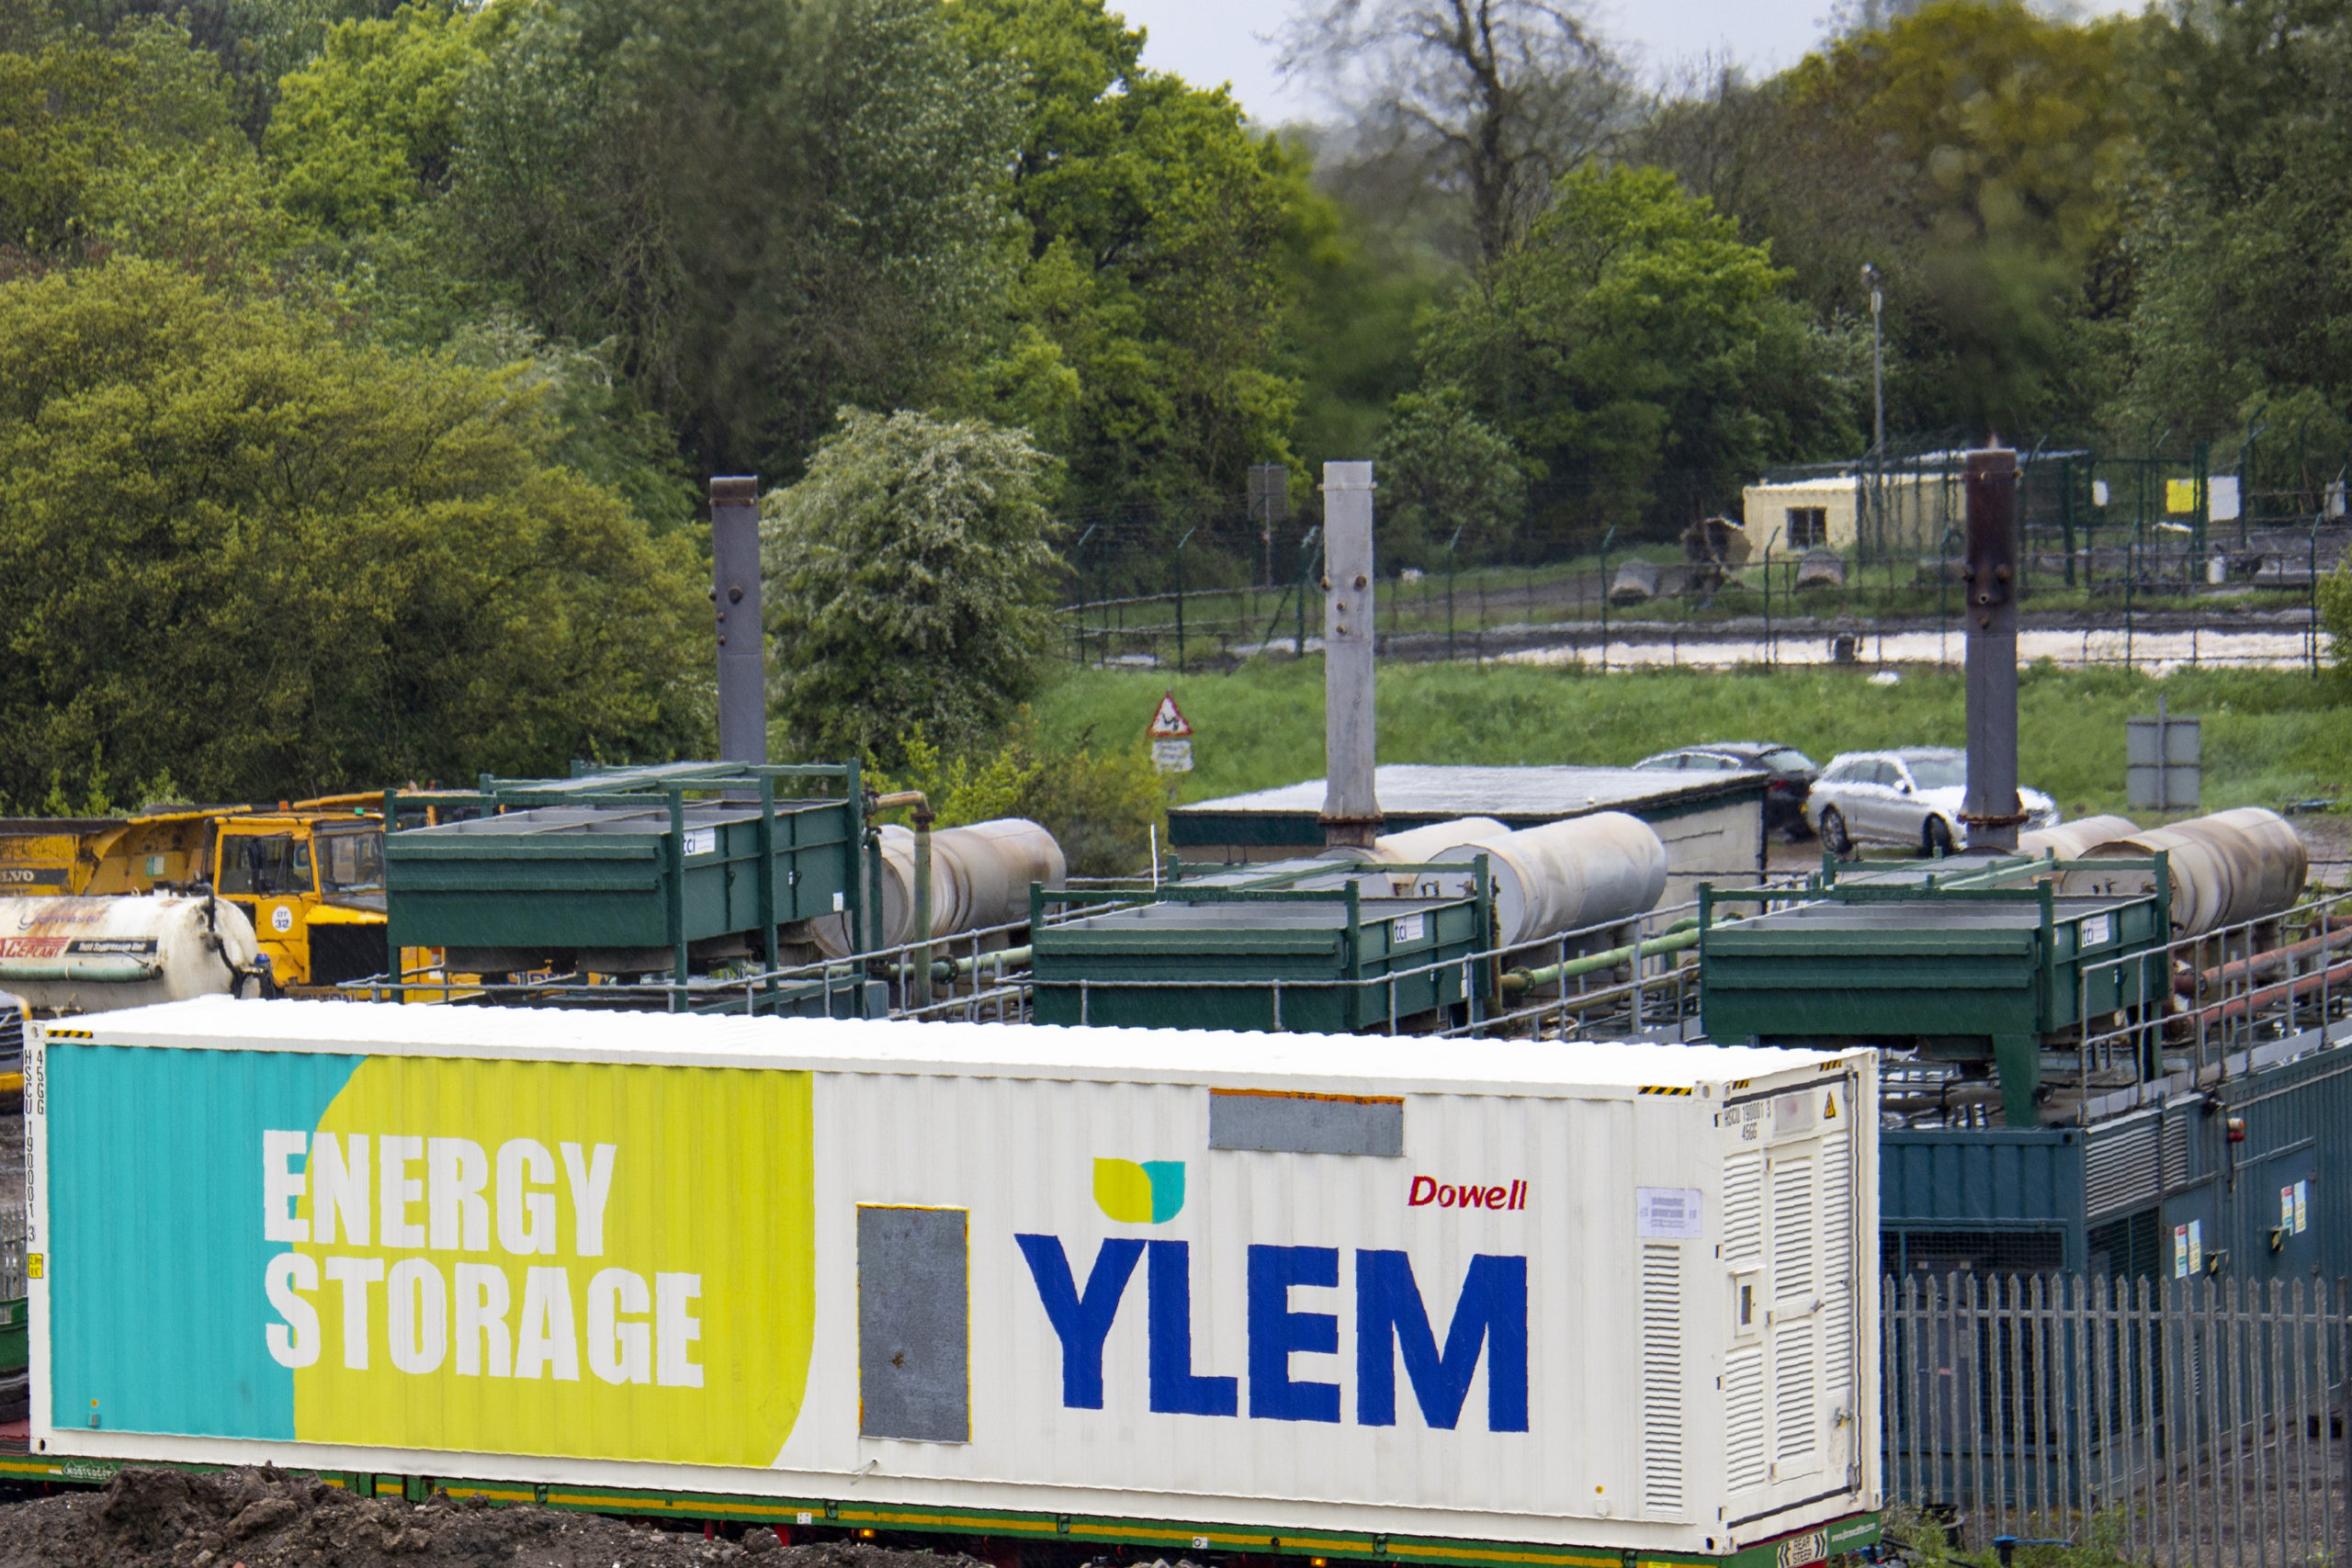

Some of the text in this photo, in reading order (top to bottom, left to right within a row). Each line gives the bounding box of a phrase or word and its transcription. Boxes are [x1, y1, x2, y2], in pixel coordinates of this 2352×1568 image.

[24, 1049, 32, 1115] HSCU
[36, 1049, 45, 1115] 45GG
[263, 1129, 617, 1257] ENERGY
[1408, 1176, 1527, 1211] Dowell
[265, 1251, 704, 1388] STORAGE
[1014, 1233, 1530, 1433] YLEM
